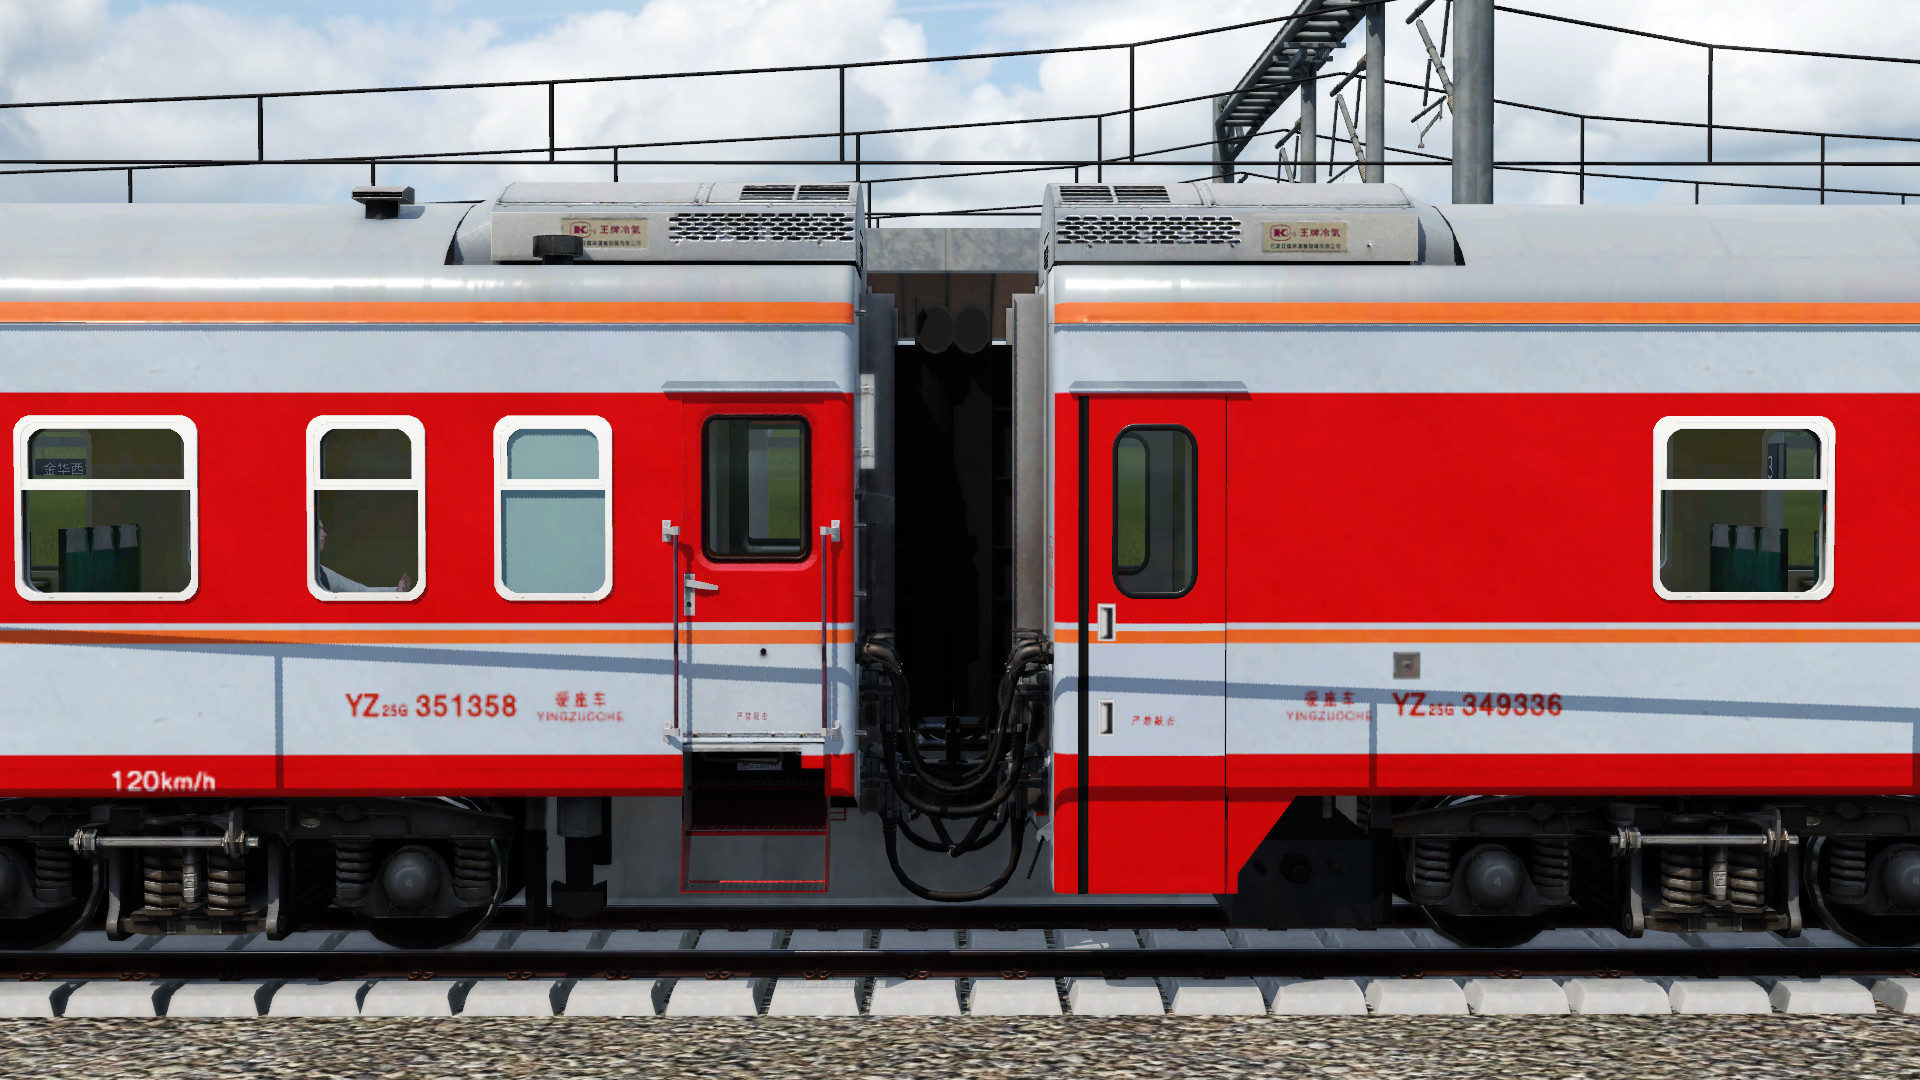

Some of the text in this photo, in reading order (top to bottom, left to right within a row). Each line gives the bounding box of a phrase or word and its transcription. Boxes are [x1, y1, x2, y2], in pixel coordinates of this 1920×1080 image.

[43, 462, 84, 476] 金华西
[415, 693, 518, 718] 351358
[1461, 692, 1563, 717] 349336
[111, 770, 216, 792] 120km/h
